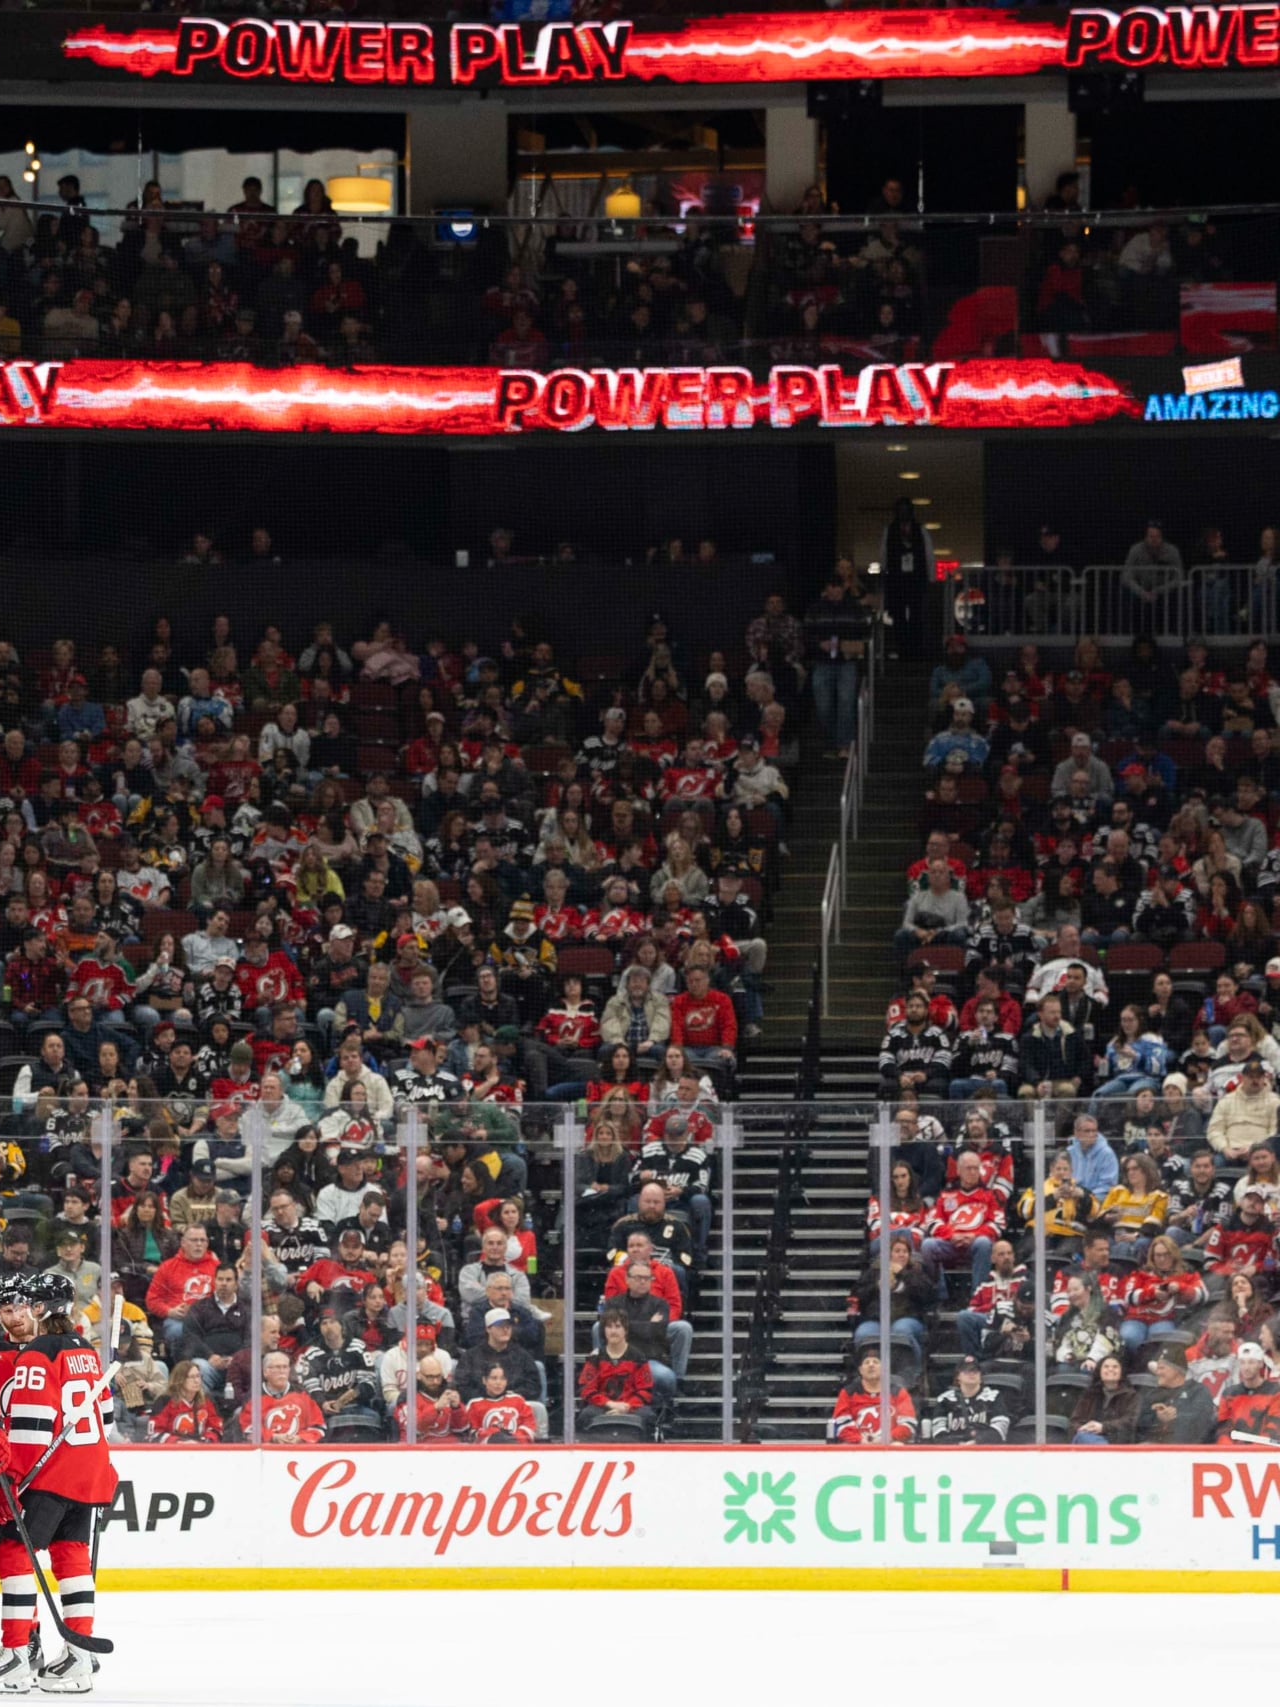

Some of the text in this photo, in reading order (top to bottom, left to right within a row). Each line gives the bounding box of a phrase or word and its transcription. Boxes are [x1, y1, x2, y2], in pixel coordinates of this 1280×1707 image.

[173, 17, 633, 83] POWER PLAY
[493, 362, 956, 432] POWER PLAY
[1144, 390, 1280, 421] AMAZING
[46, 1118, 56, 1130] 6
[663, 1225, 674, 1238] C
[1109, 1277, 1118, 1289] C
[13, 1365, 46, 1391] 86
[320, 1370, 354, 1391] Jersey
[286, 1458, 636, 1555] Campbell's
[815, 1474, 1142, 1545] Citizens
